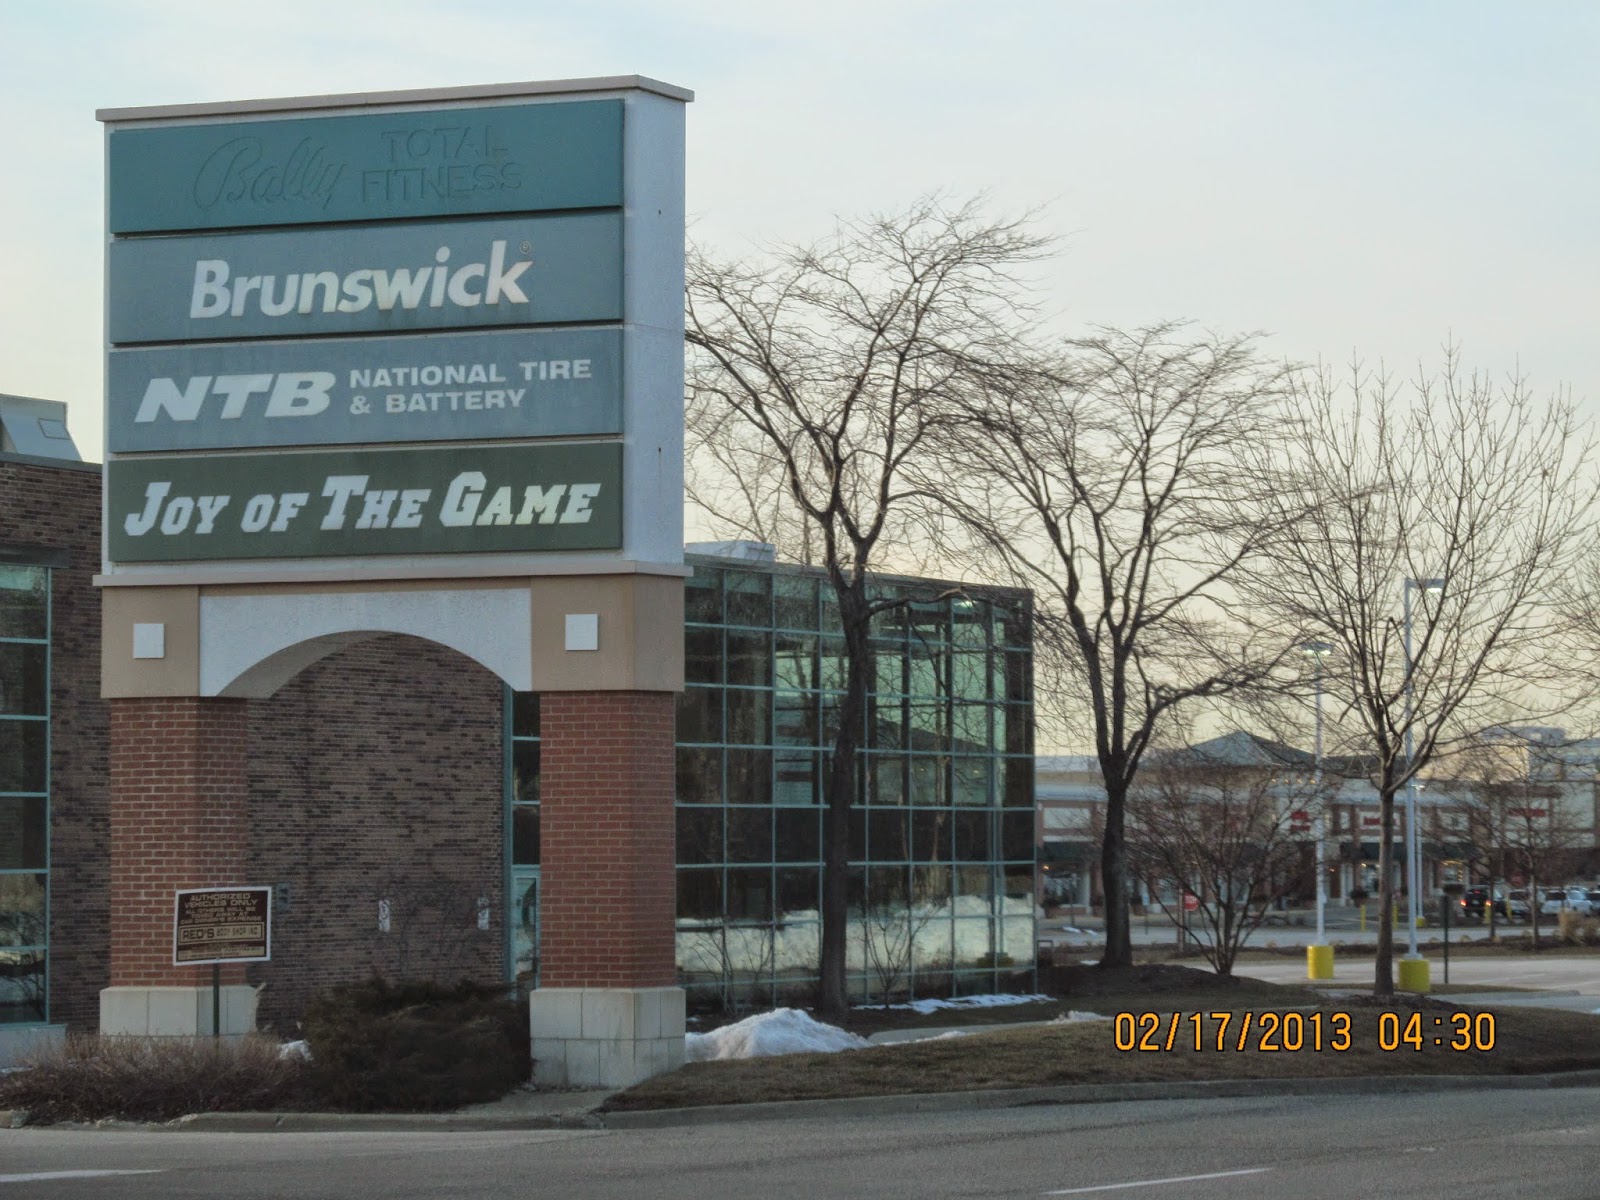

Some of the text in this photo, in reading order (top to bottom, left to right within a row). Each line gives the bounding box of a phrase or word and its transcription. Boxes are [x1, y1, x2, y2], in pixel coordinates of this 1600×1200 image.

[381, 125, 508, 161] TOTAL
[192, 135, 347, 211] Bally
[362, 162, 523, 202] FITNESS
[190, 240, 534, 319] Brunswick
[349, 359, 592, 388] NATIONAL TIRE
[134, 371, 336, 423] NTB
[349, 388, 526, 415] & BATTERY
[124, 471, 602, 537] JOY OF THE GAME
[184, 900, 227, 908] VEHICLES
[190, 893, 251, 901] AUTHORIZED
[182, 928, 215, 939] RED'S
